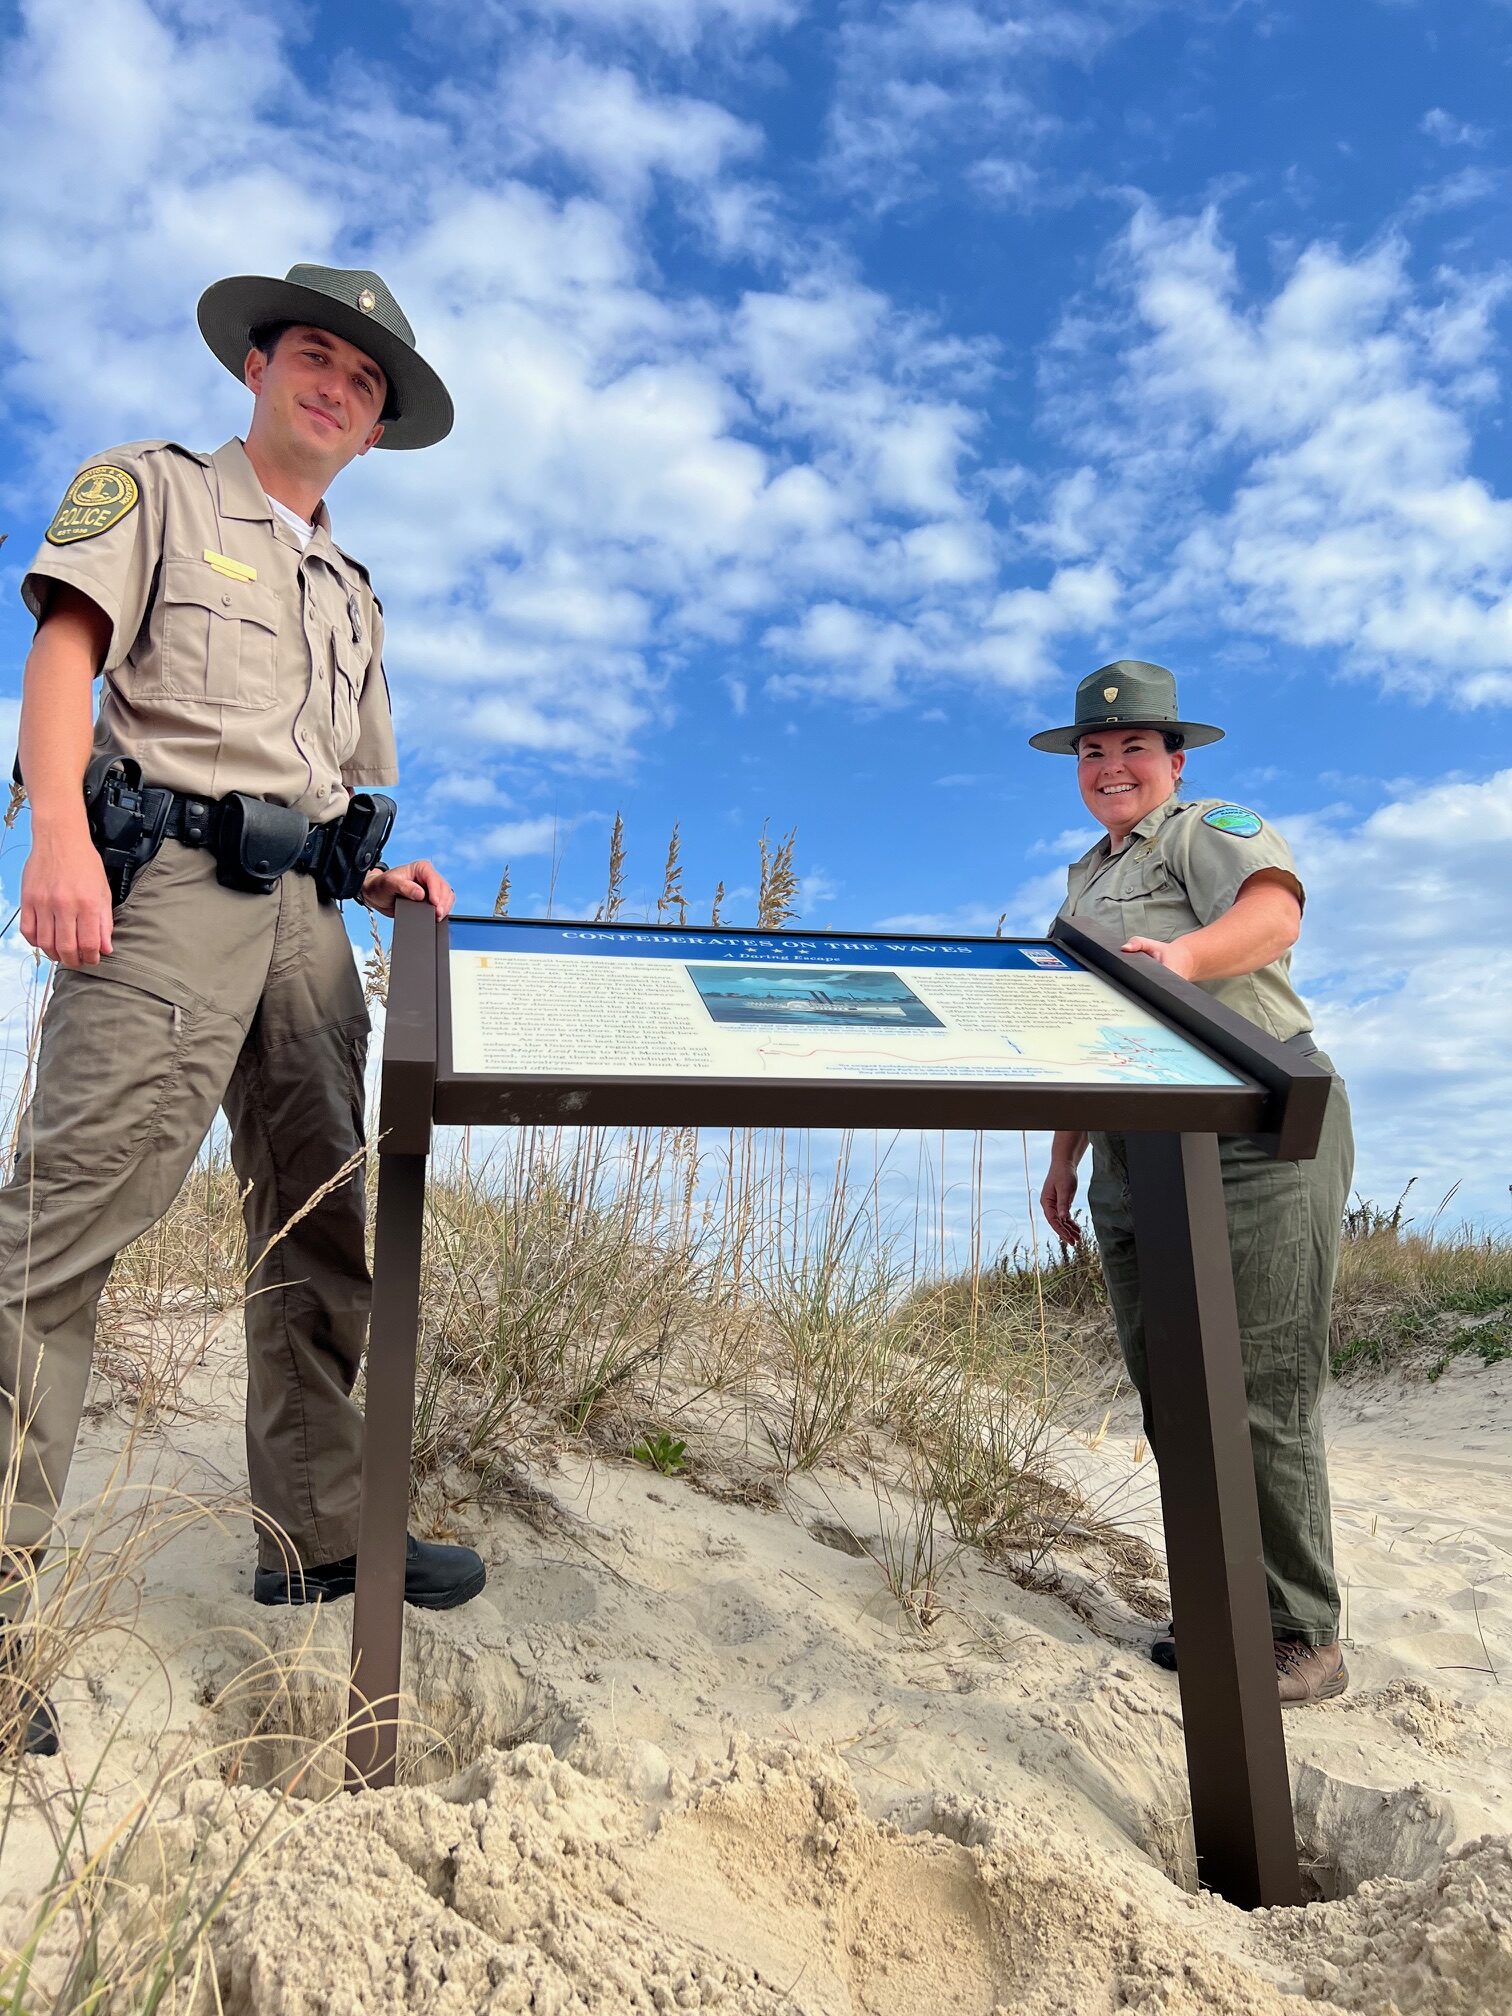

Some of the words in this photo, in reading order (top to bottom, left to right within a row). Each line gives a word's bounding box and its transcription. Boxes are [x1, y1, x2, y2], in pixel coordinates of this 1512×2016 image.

[56, 507, 111, 528] POLICE
[562, 932, 773, 947] CONFEDERATES
[782, 940, 816, 949] ON
[824, 942, 878, 951] THE
[884, 944, 973, 954] WAVES
[740, 953, 789, 961] Daring
